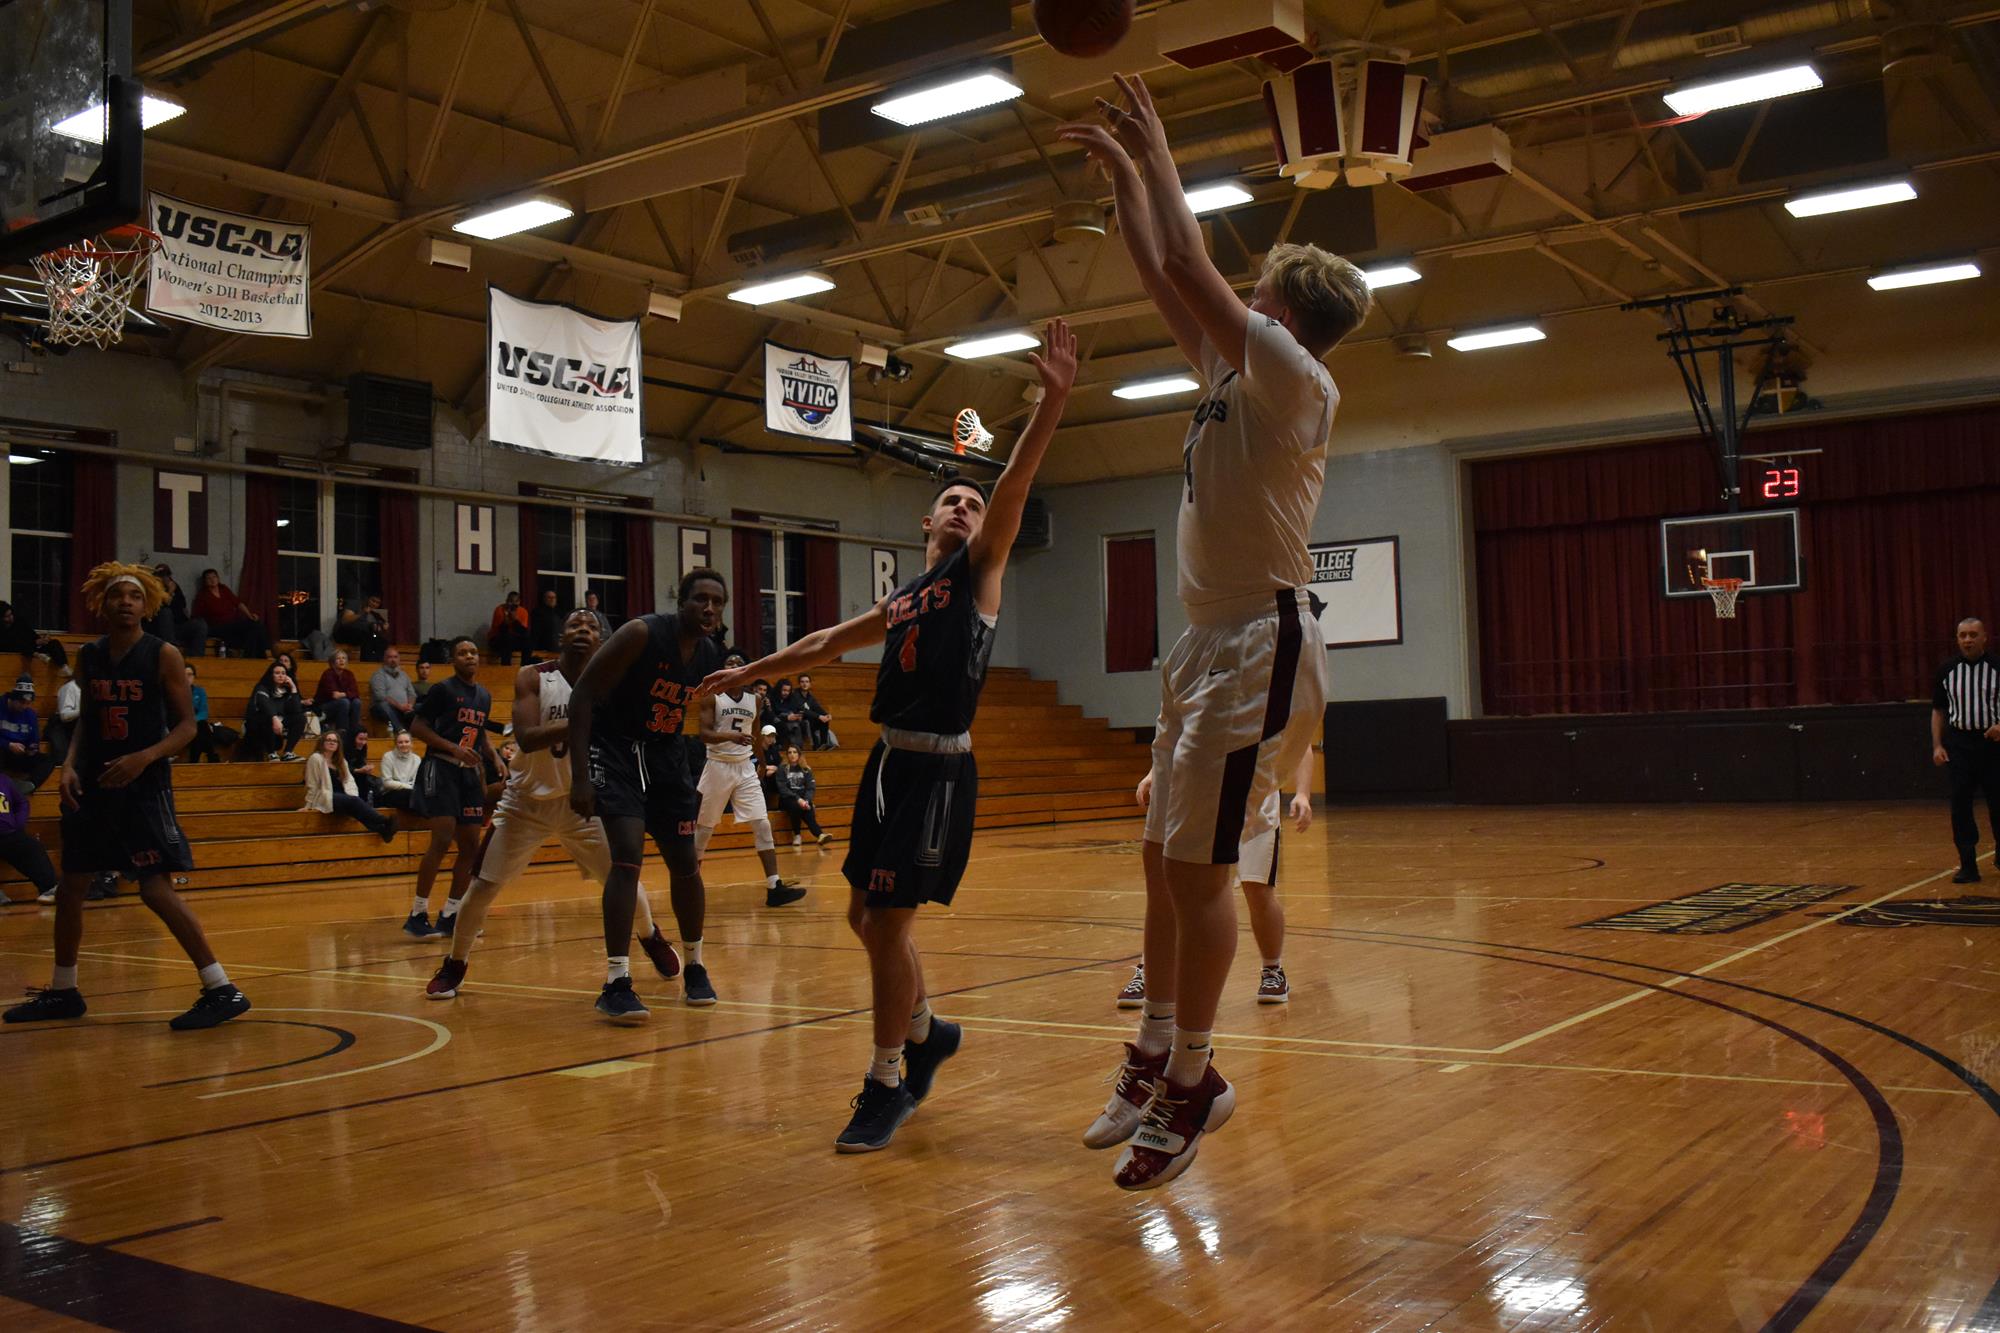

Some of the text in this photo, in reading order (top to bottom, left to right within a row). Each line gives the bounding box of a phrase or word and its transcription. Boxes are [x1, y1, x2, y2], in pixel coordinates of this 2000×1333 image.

[158, 205, 303, 262] USCAA
[159, 245, 302, 288] National Champions
[157, 267, 213, 294] Women's
[242, 289, 304, 306] Basketball
[200, 302, 262, 324] 2012-2013
[497, 340, 635, 399] USCAA
[497, 382, 519, 394] UNITED
[536, 393, 571, 407] COLLEGIATE
[571, 400, 594, 412] ATHLETIC
[785, 379, 836, 407] HVIAC
[1764, 469, 1799, 498] 23
[159, 472, 203, 549] T
[458, 504, 493, 572] H
[873, 549, 896, 604] R
[1311, 551, 1353, 571] LLEGE
[1319, 570, 1351, 580] SCIENCES
[650, 677, 697, 706] COLT
[645, 703, 683, 734] 32
